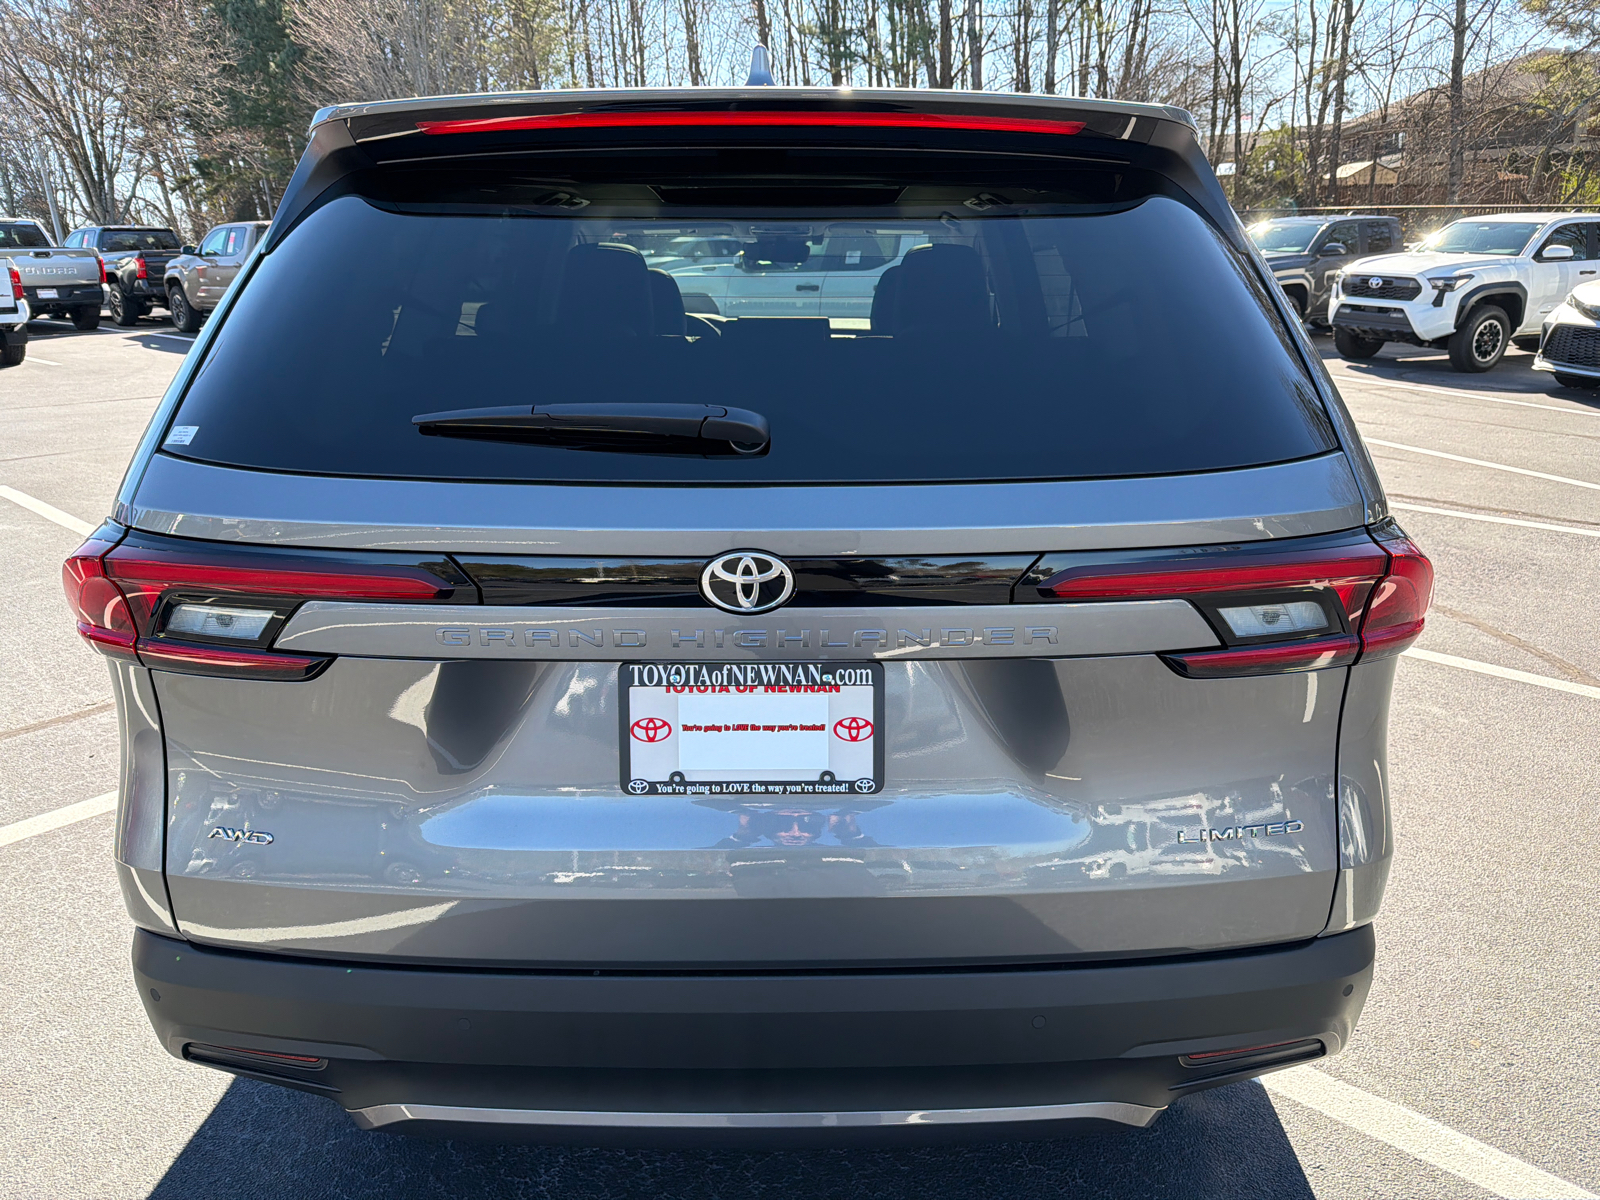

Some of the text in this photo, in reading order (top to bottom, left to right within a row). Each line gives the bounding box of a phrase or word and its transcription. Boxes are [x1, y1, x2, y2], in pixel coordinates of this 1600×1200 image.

[435, 626, 1059, 648] GRAND HIGHLANDER
[703, 724, 722, 732] going
[686, 784, 710, 795] going
[711, 784, 721, 793] to
[722, 783, 750, 793] LOVE
[751, 783, 766, 793] the
[767, 785, 784, 795] way
[815, 783, 849, 793] treated!
[207, 826, 274, 845] AWD
[1178, 820, 1304, 844] LIMITED
